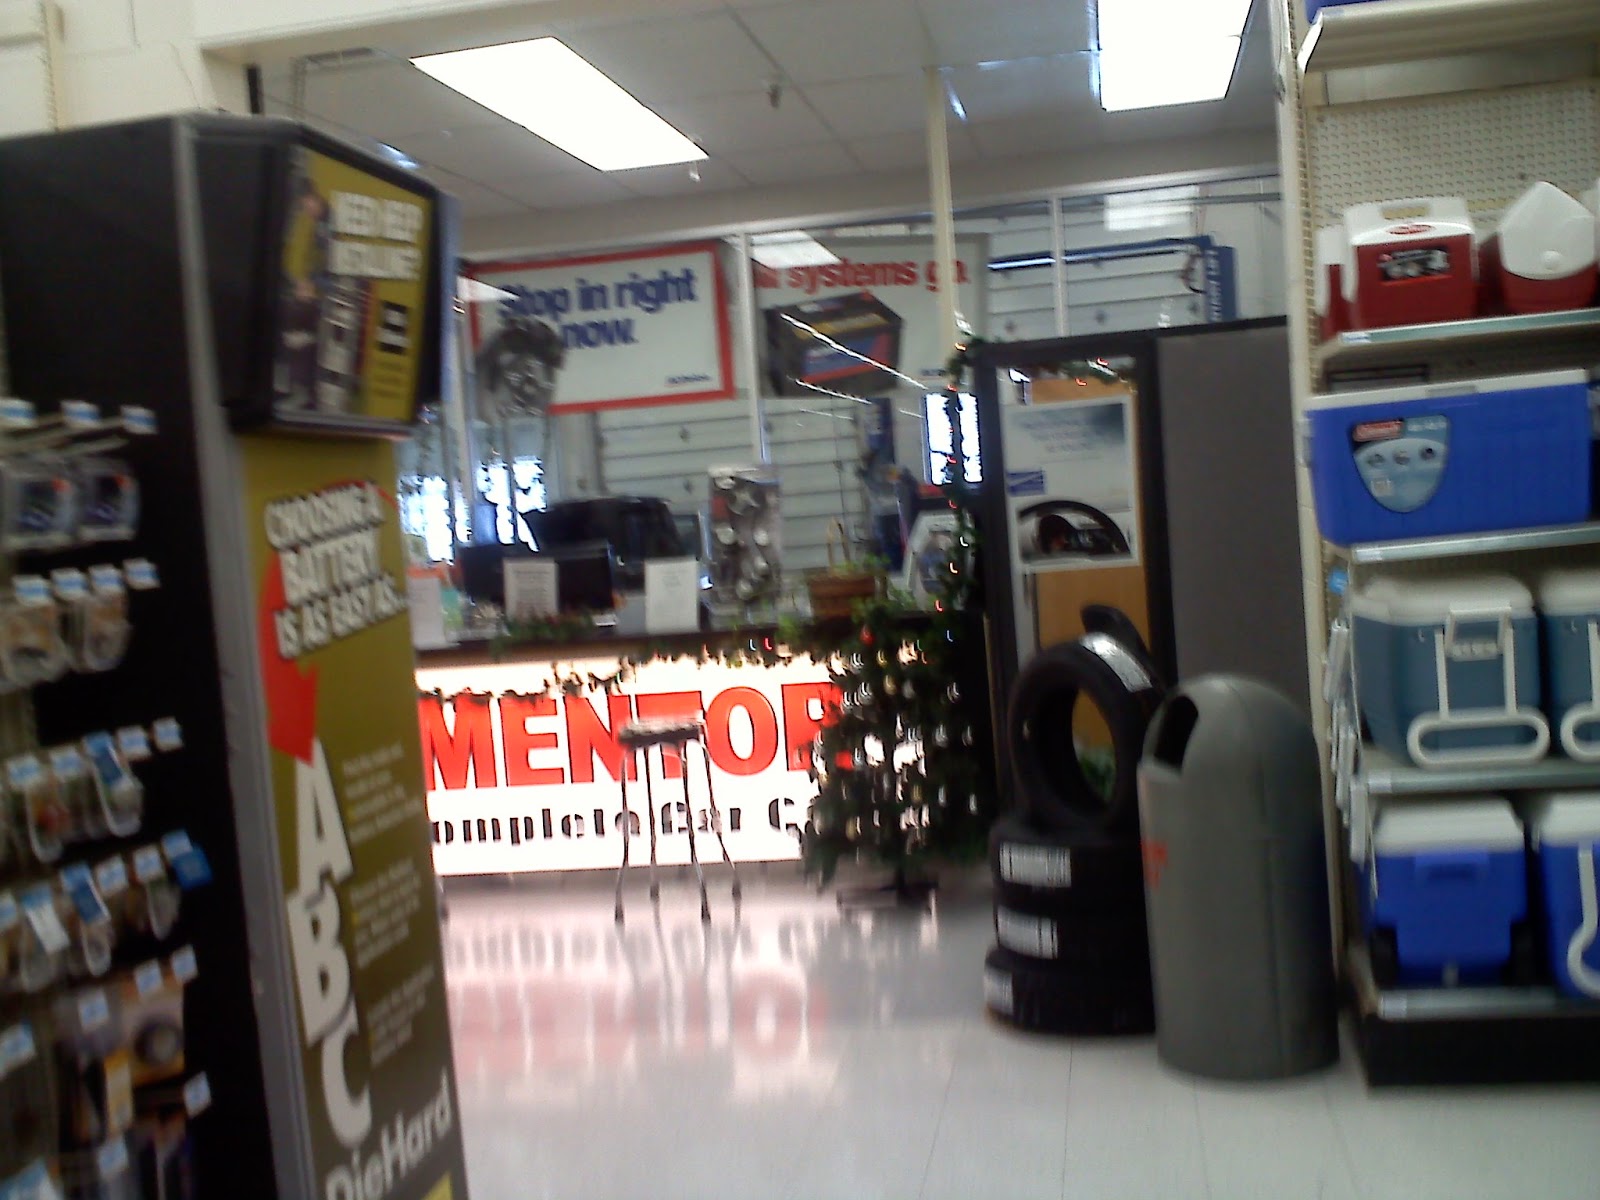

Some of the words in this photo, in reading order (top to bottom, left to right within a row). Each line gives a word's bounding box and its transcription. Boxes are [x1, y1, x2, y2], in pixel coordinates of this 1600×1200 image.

[575, 276, 608, 311] in
[614, 268, 697, 313] right
[293, 736, 353, 898] A
[430, 808, 641, 846] omplete
[287, 882, 350, 1048] B
[321, 995, 373, 1149] C
